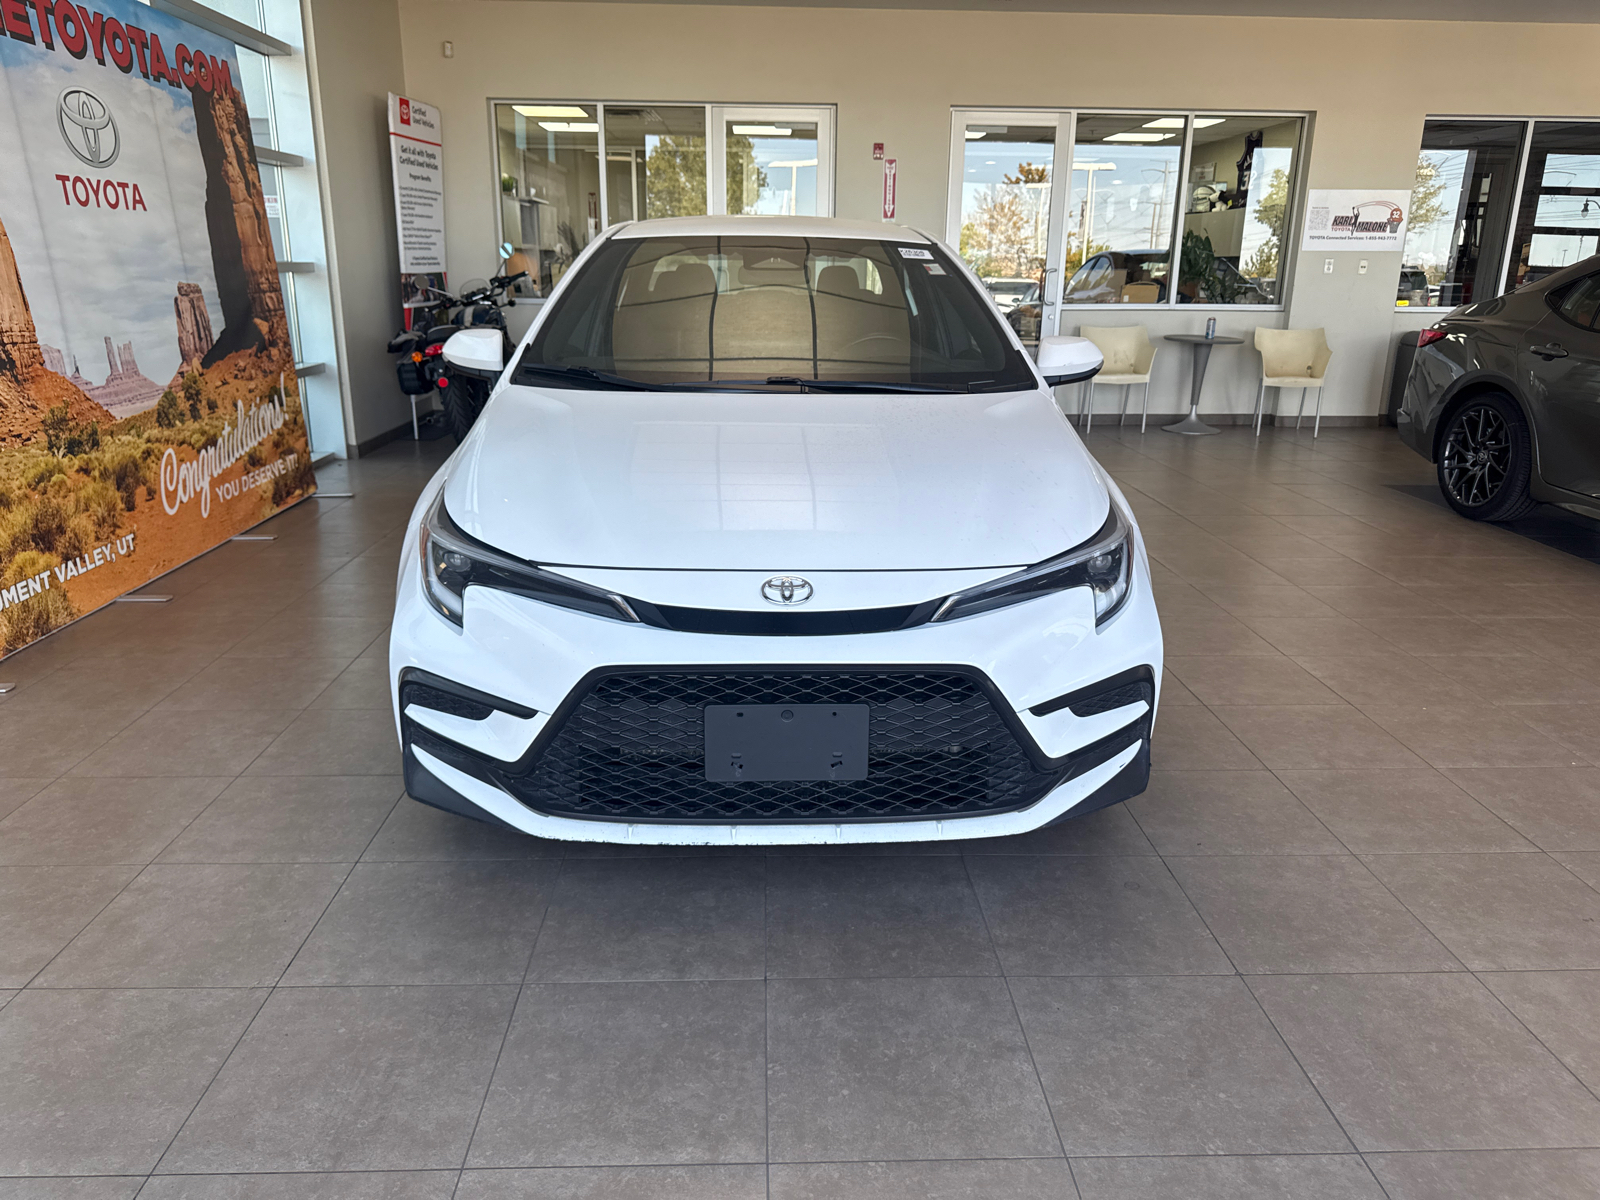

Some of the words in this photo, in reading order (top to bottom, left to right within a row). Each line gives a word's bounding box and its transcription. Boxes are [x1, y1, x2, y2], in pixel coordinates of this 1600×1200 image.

[0, 0, 235, 99] ETOYOTA.COM
[55, 174, 147, 212] TOYOTA
[1332, 215, 1354, 227] KARL
[1355, 221, 1389, 233] MALONE
[160, 371, 289, 518] Congratulations!
[215, 481, 240, 503] YOU
[241, 460, 285, 492] DESERVE
[286, 452, 298, 474] IT!
[54, 543, 116, 583] VALLEY,
[117, 533, 135, 556] UT
